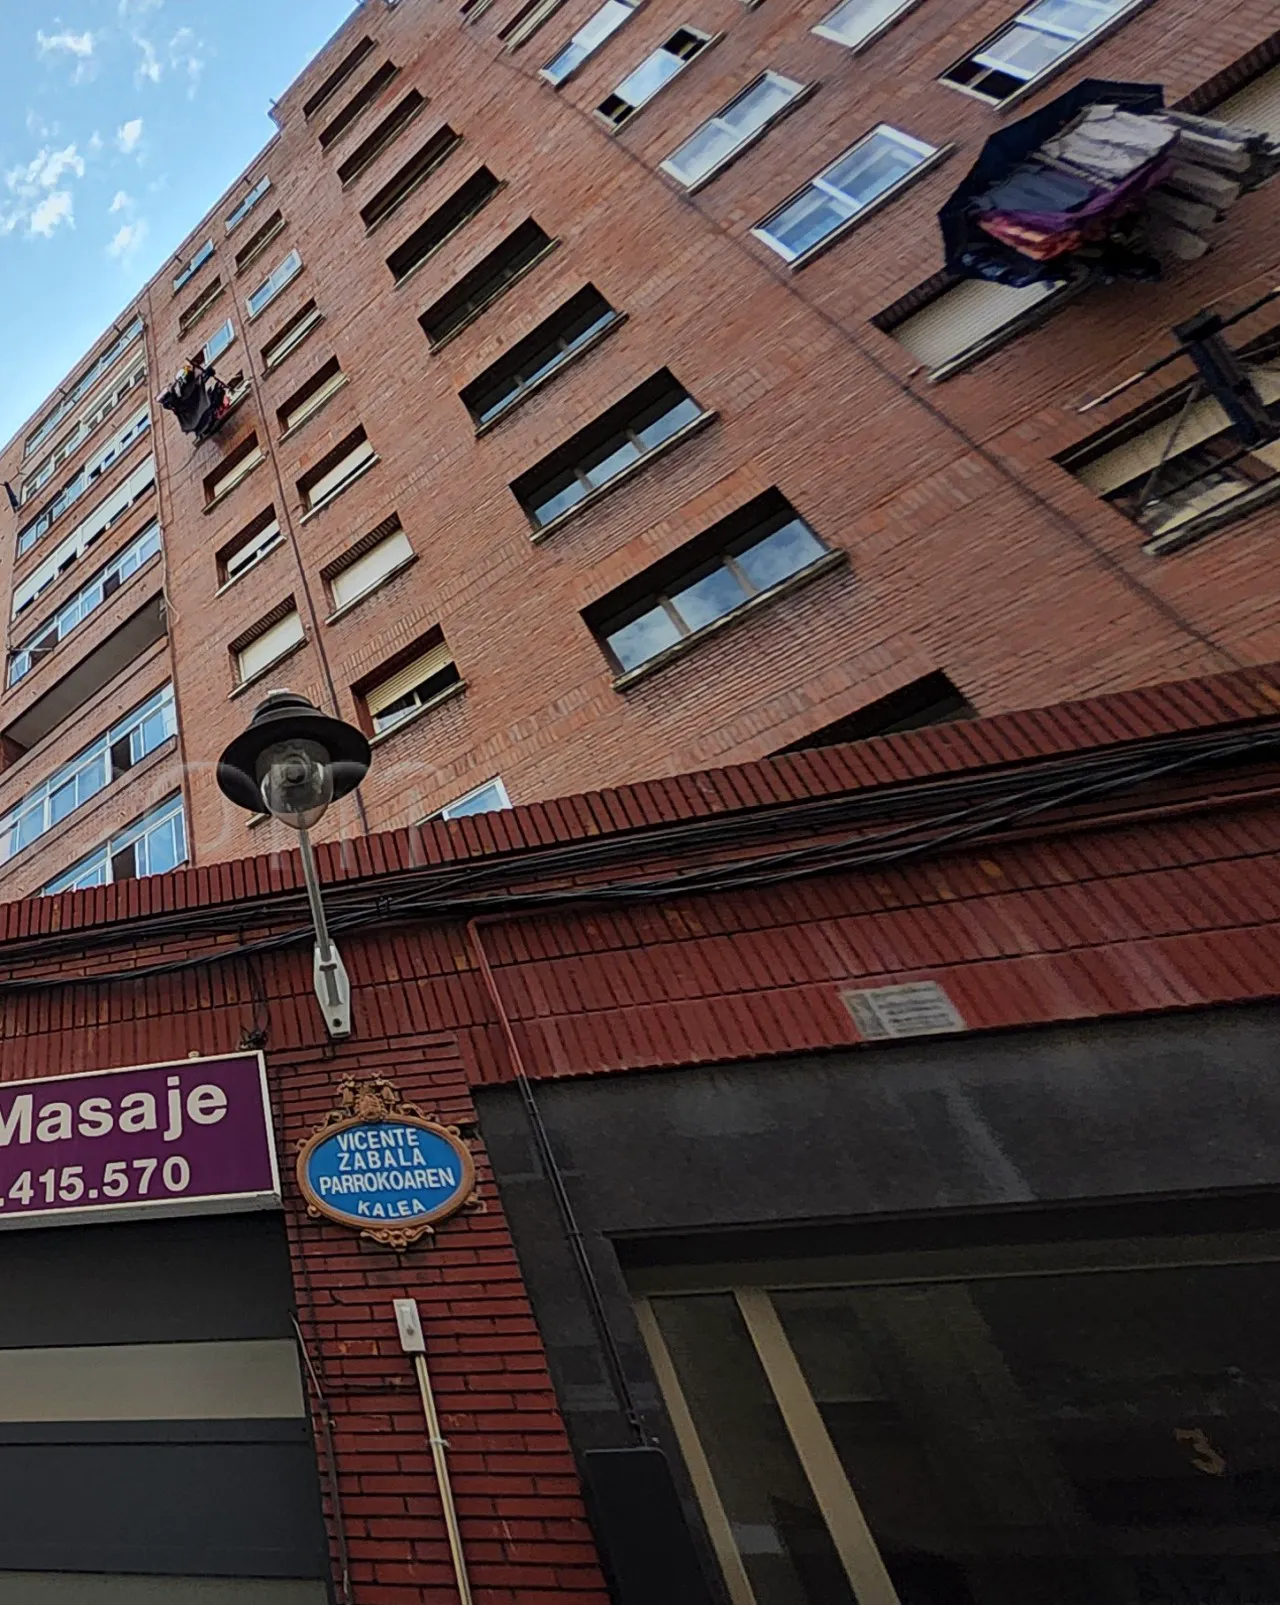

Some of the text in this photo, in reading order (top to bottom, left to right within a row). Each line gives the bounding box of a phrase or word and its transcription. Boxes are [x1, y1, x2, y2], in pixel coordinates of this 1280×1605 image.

[337, 1128, 420, 1151] VICENTE
[337, 1148, 427, 1171] ZABALA
[319, 1167, 456, 1195] PARROKOAREN
[358, 1199, 426, 1217] KALEA
[1173, 1428, 1226, 1477] 3
